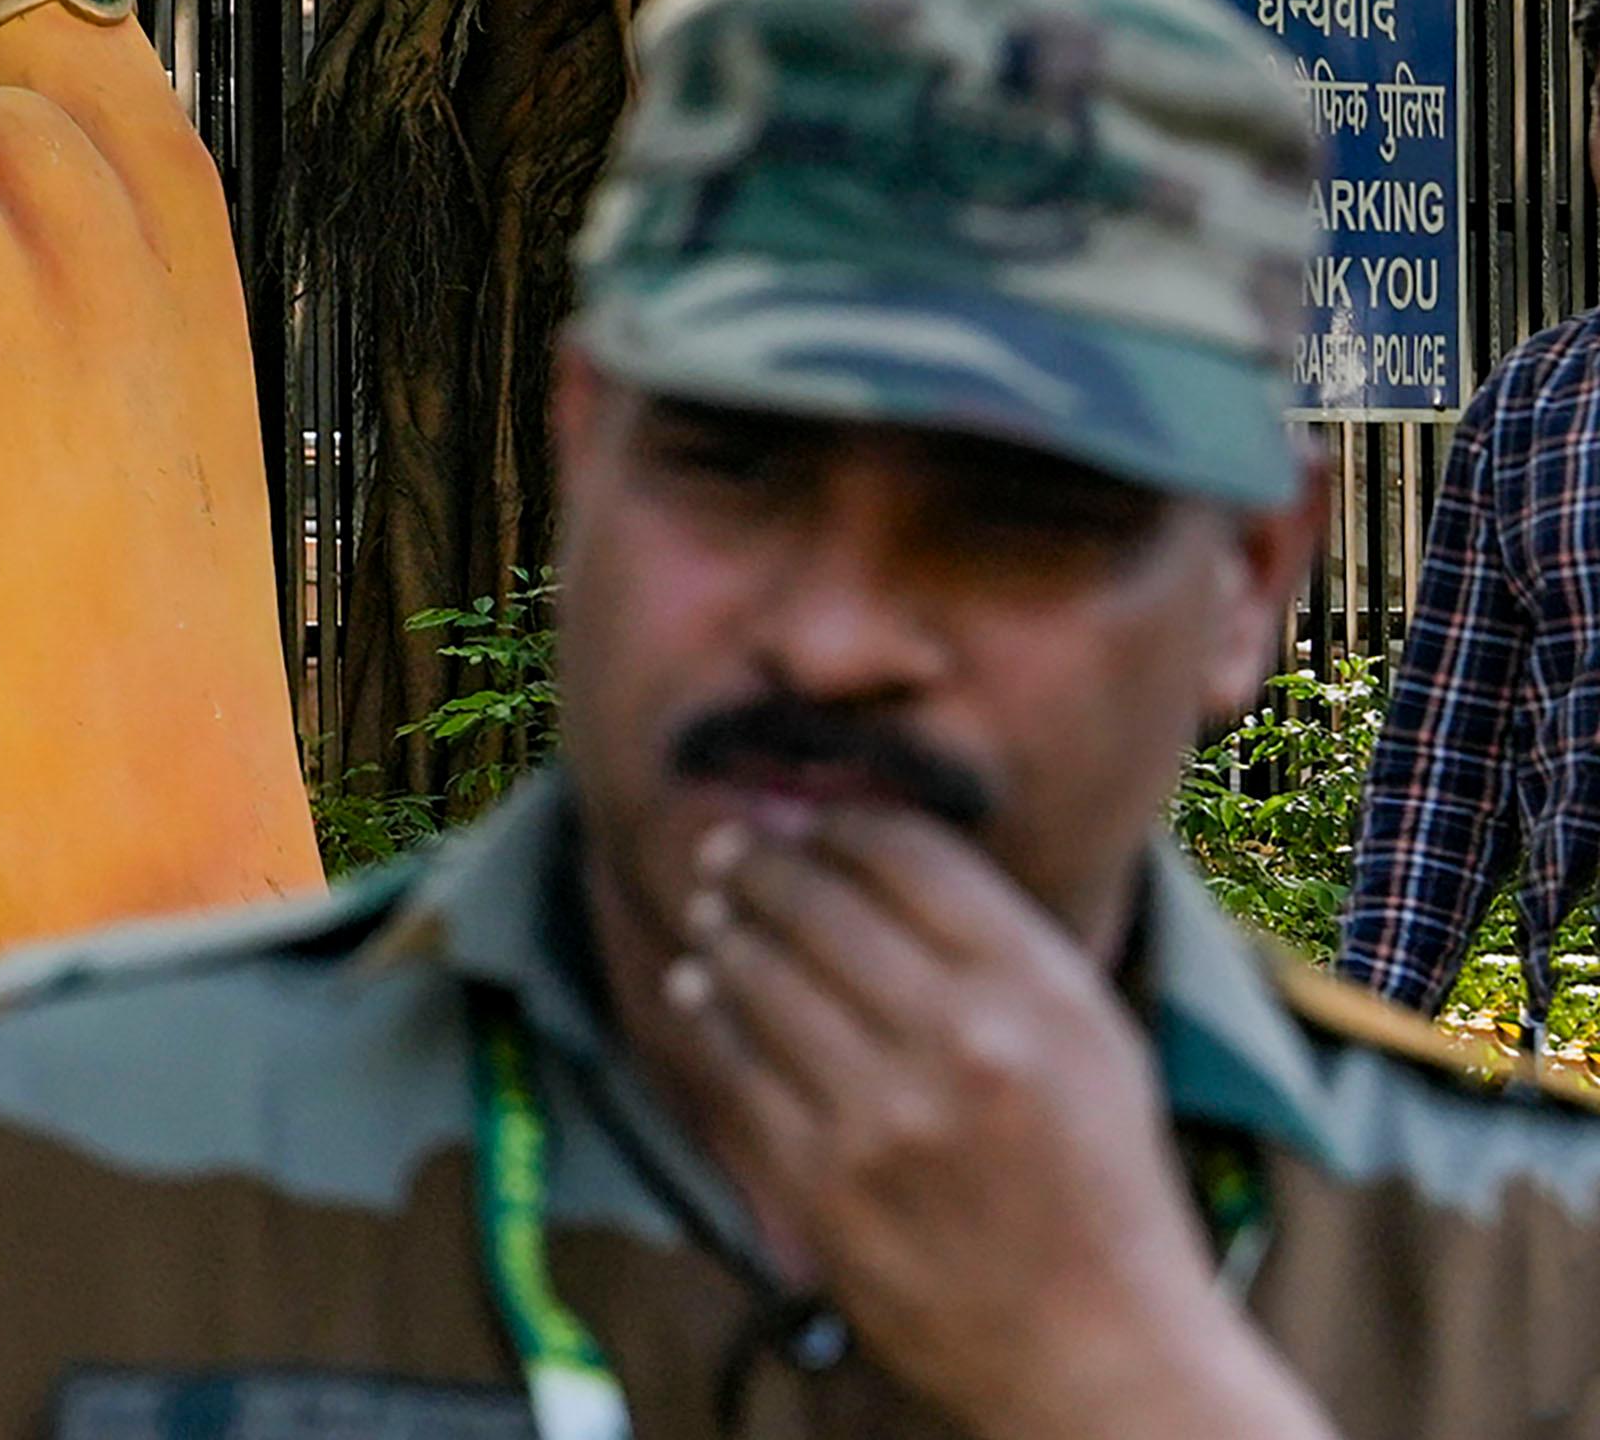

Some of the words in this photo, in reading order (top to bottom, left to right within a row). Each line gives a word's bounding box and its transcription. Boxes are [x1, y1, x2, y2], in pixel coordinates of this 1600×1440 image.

[1376, 62, 1445, 162] पुलिस
[1308, 180, 1445, 234] ARKING
[1362, 257, 1438, 310] YOU
[1373, 334, 1446, 386] POLICE
